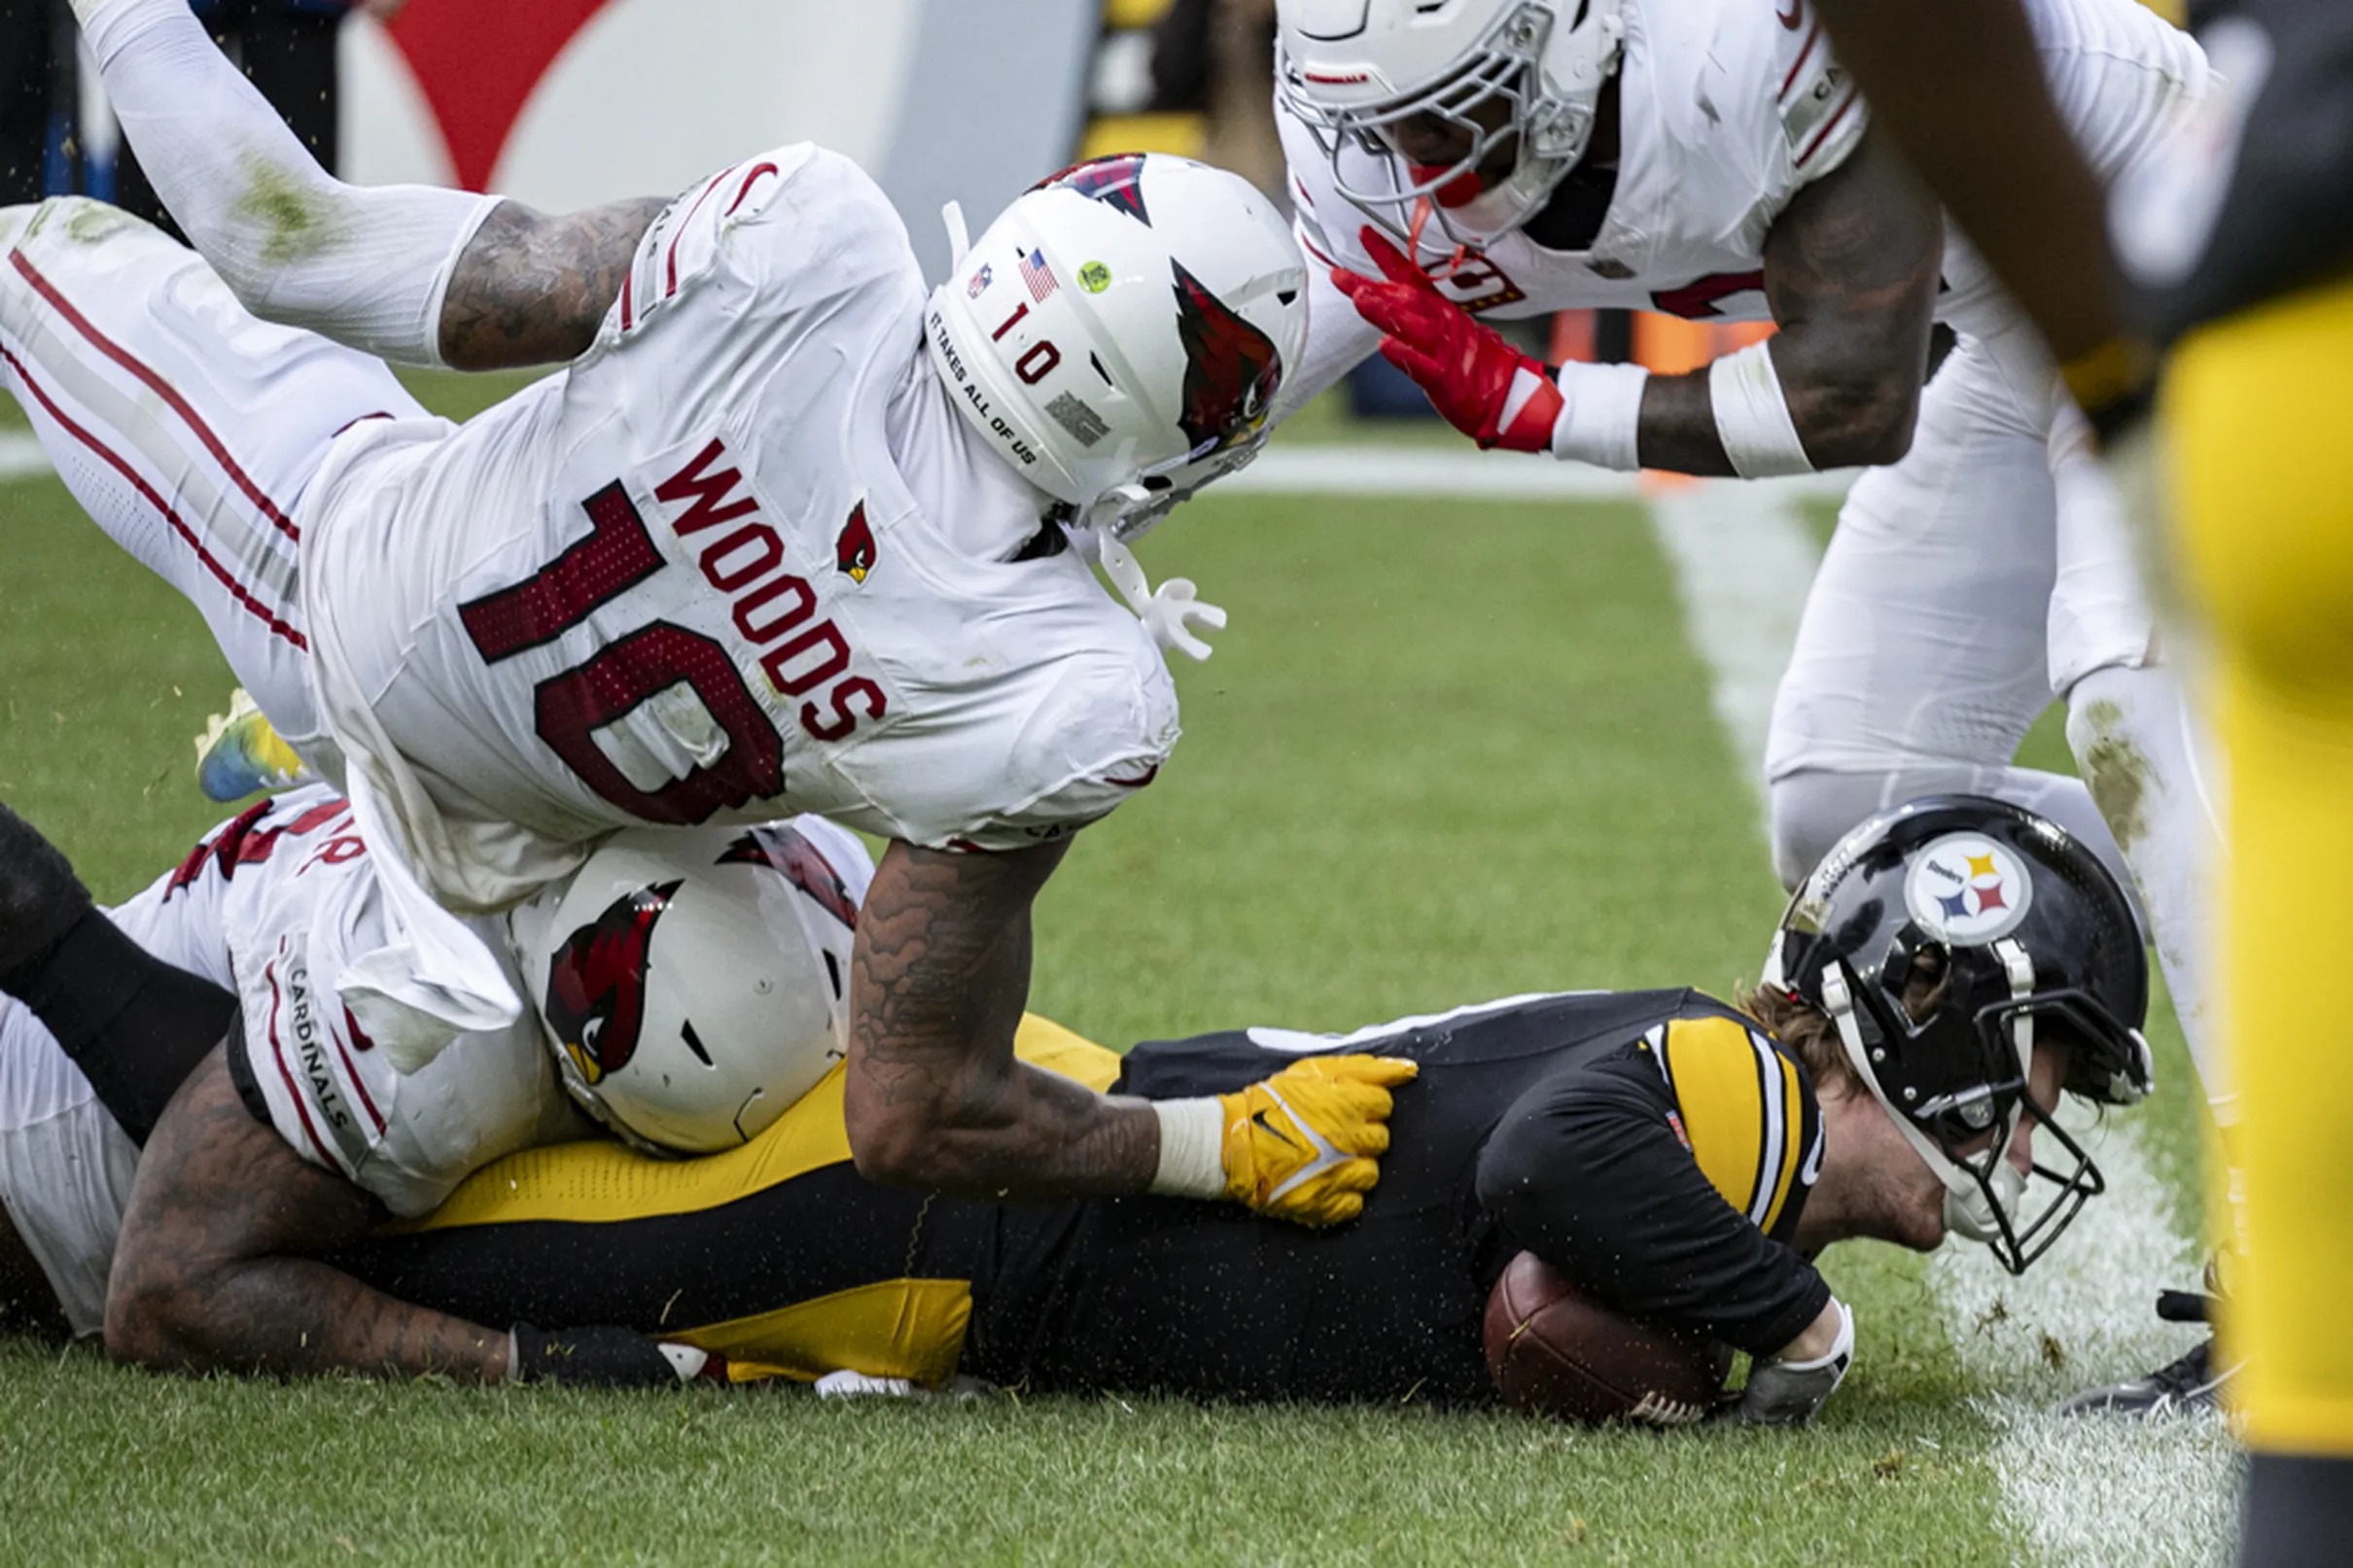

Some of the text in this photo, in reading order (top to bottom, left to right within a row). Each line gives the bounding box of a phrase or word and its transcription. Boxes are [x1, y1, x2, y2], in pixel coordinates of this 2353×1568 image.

[930, 312, 1037, 465] IT TAKES ALL OF US
[992, 301, 1060, 385] 10
[457, 477, 786, 826] 10
[654, 436, 887, 743] WOODS
[291, 968, 349, 1130] CARDINALS
